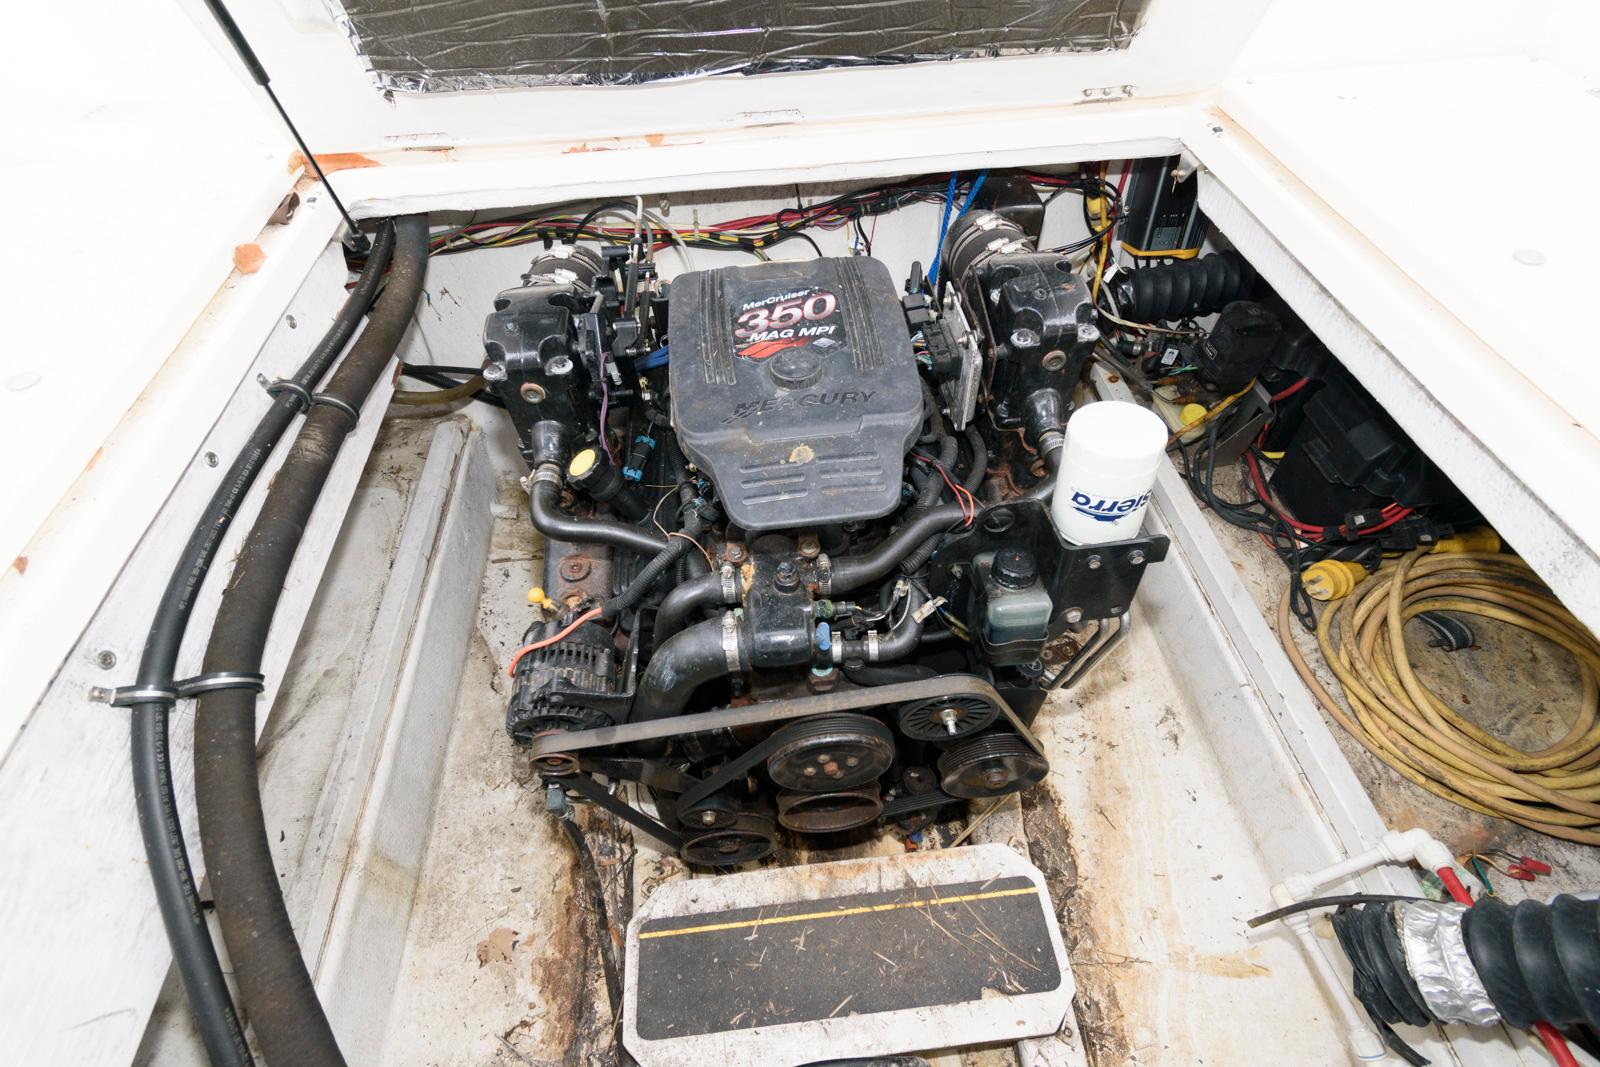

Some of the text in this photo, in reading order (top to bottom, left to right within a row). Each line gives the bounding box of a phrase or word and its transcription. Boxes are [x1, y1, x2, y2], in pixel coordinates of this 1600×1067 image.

[742, 289, 810, 311] MerCruiser
[735, 291, 836, 338] 350
[749, 325, 836, 342] MAG MPI
